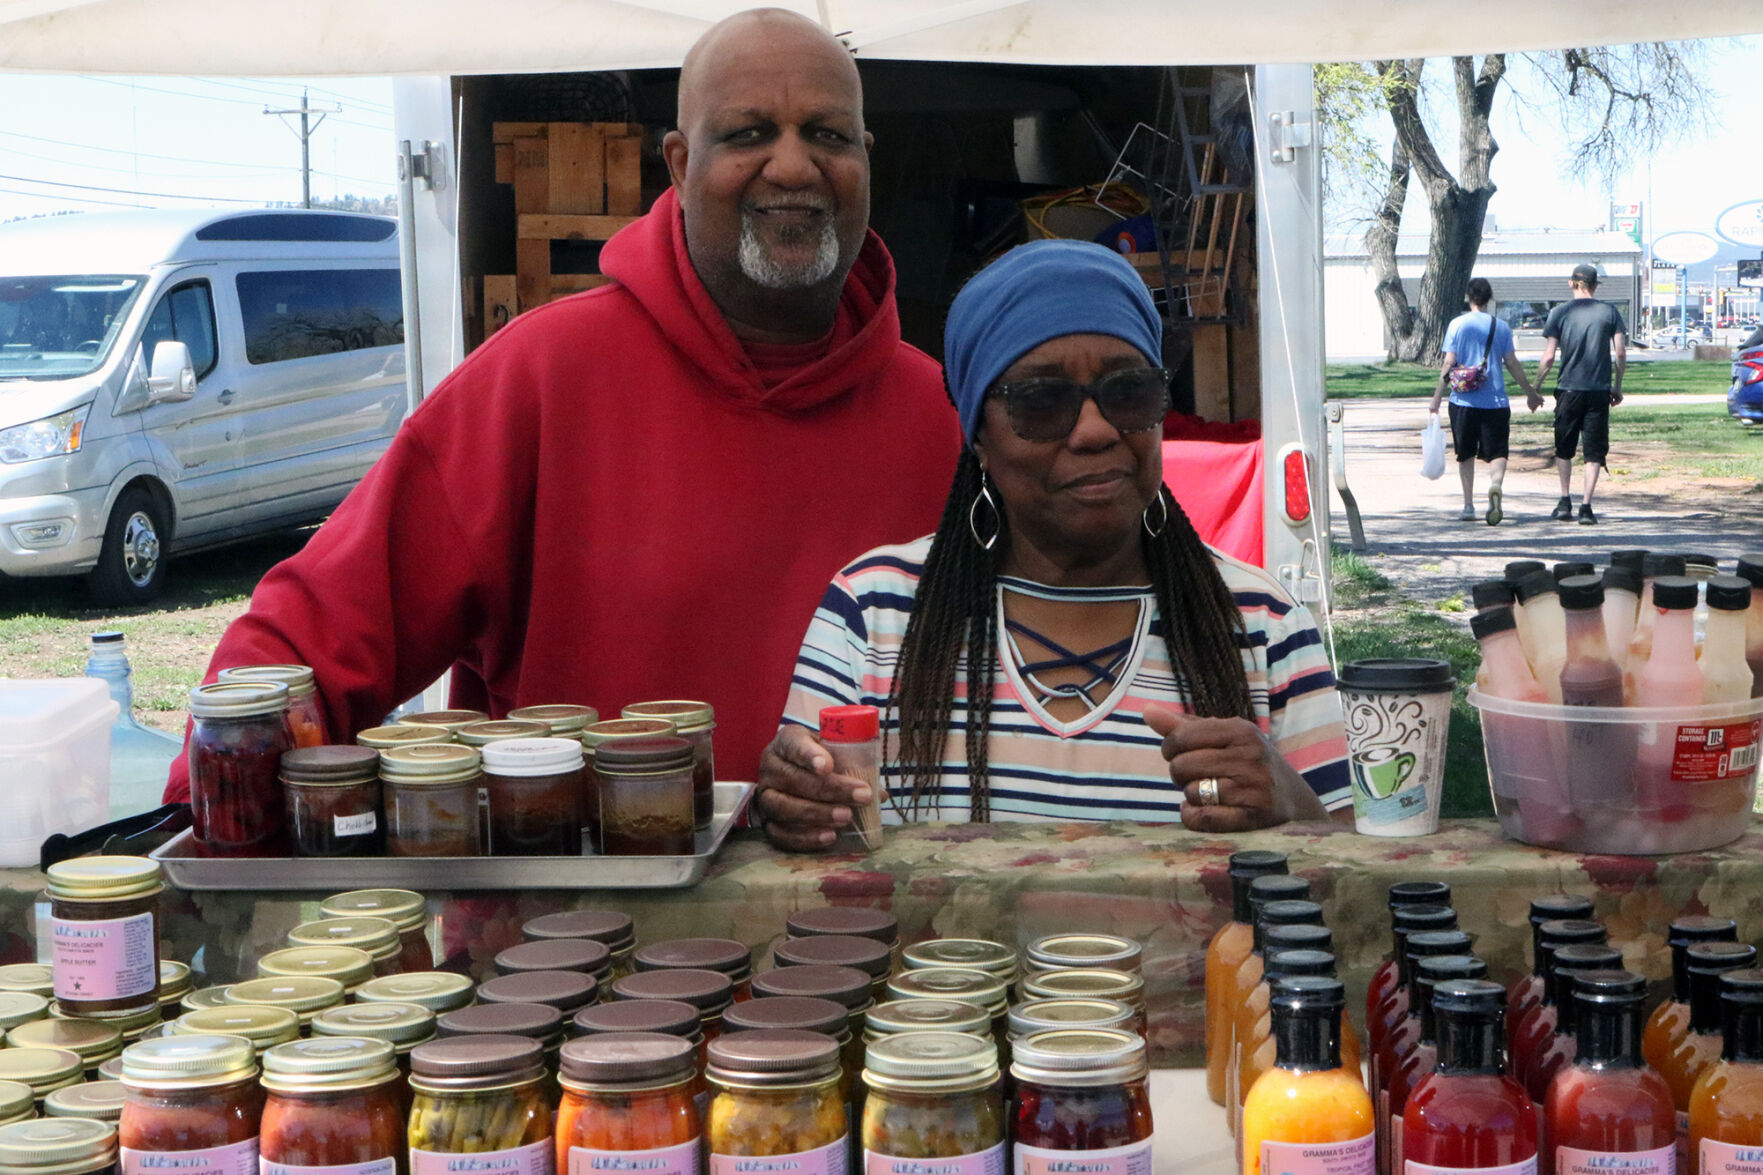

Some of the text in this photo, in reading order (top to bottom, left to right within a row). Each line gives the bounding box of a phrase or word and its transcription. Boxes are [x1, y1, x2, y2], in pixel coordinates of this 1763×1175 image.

[1681, 727, 1705, 735] STORAGE
[1303, 1148, 1344, 1158] GRAMMA'S
[1571, 1165, 1660, 1175] GRAMMA'S DELICACIES
